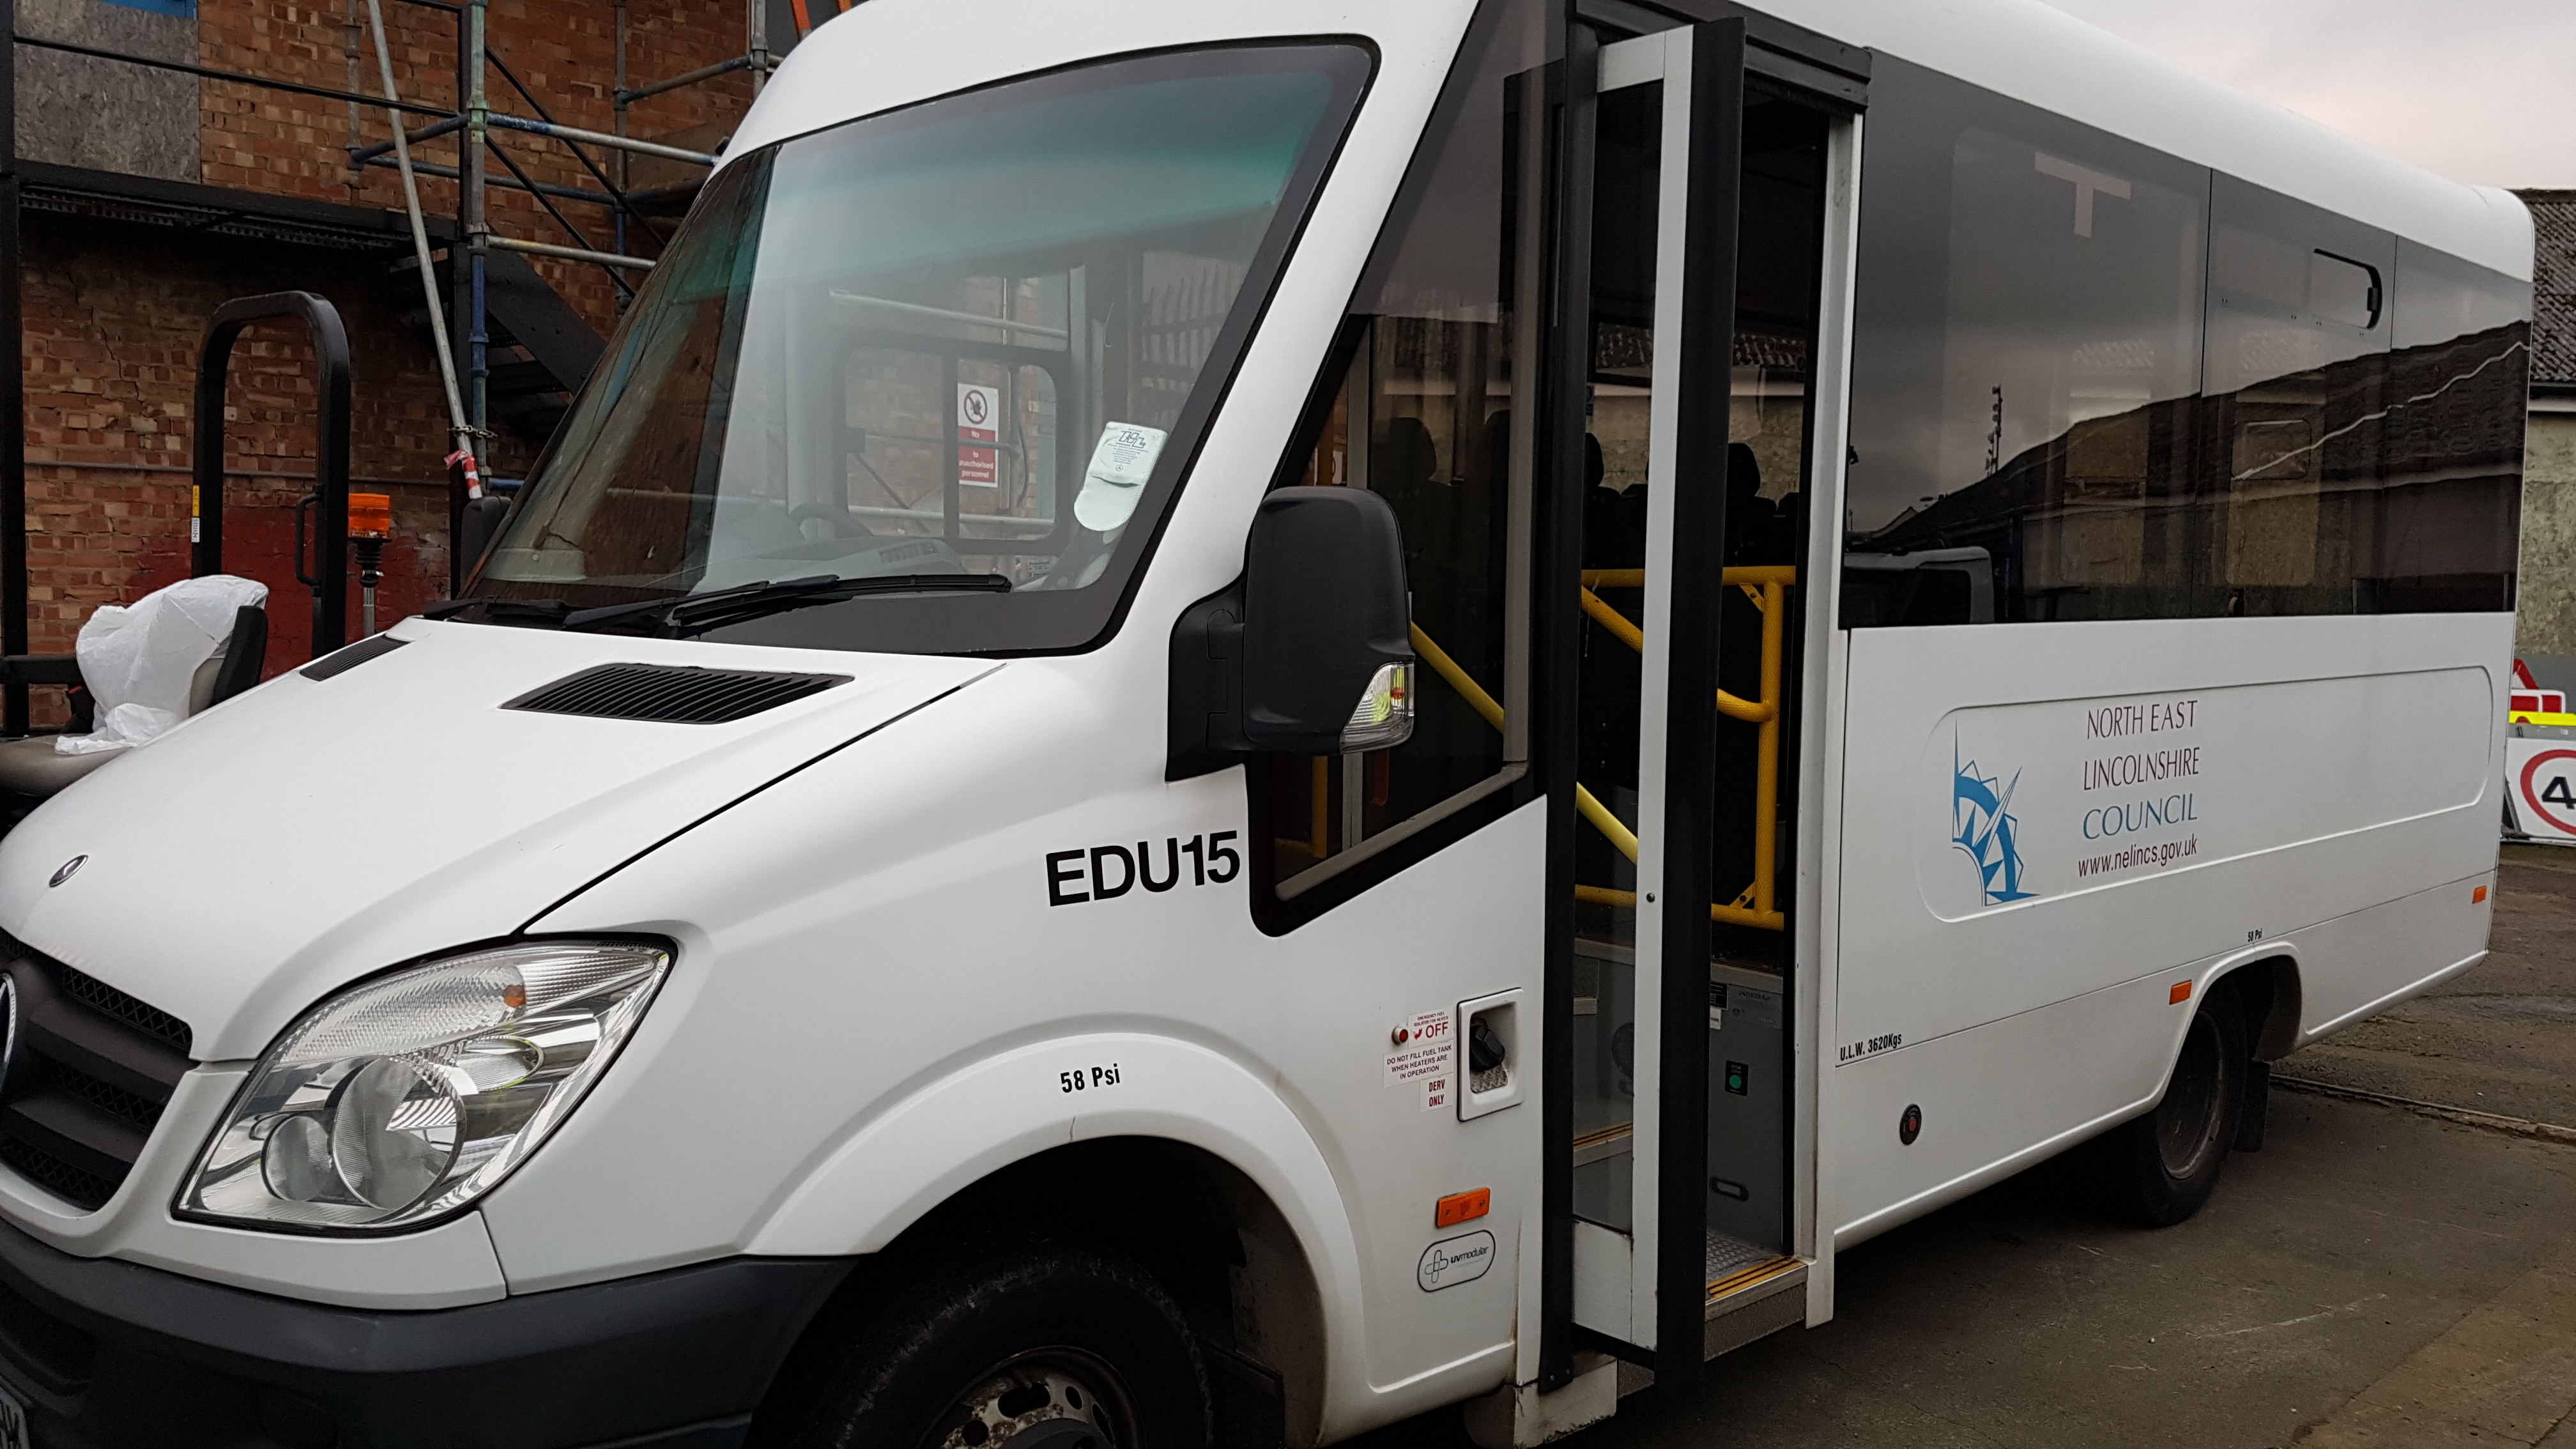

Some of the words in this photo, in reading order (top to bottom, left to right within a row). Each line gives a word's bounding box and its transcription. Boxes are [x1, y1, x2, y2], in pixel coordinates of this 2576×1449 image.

[971, 430, 980, 438] No
[972, 450, 979, 458] to
[962, 470, 990, 479] personnel
[2087, 704, 2143, 740] NORTH
[2150, 700, 2198, 732] EAST
[2083, 747, 2200, 790] LINCOLNSHIRE
[2083, 793, 2198, 839] COUNCIL
[2078, 833, 2198, 878] www.nelincs.gov.uk
[1046, 830, 1241, 907] EDU15
[2248, 930, 2254, 943] 58
[1425, 1022, 1448, 1038] OFF
[1397, 1054, 1409, 1062] NOT
[1409, 1052, 1422, 1060] FILL
[1422, 1048, 1437, 1057] FUEL
[1438, 1045, 1452, 1053] TANK
[1840, 1041, 1865, 1061] U.L.W.
[1867, 1033, 1902, 1053] 3620Kgs
[1392, 1064, 1409, 1073] WHEN
[1409, 1058, 1436, 1069] HEATERS
[1407, 1065, 1439, 1078] OPERATION
[1061, 1070, 1085, 1093] 58
[1091, 1063, 1120, 1087] Psi
[1429, 1079, 1445, 1092] DERV
[1429, 1094, 1445, 1107] ONLY
[1450, 1246, 1489, 1263] uvmodular
